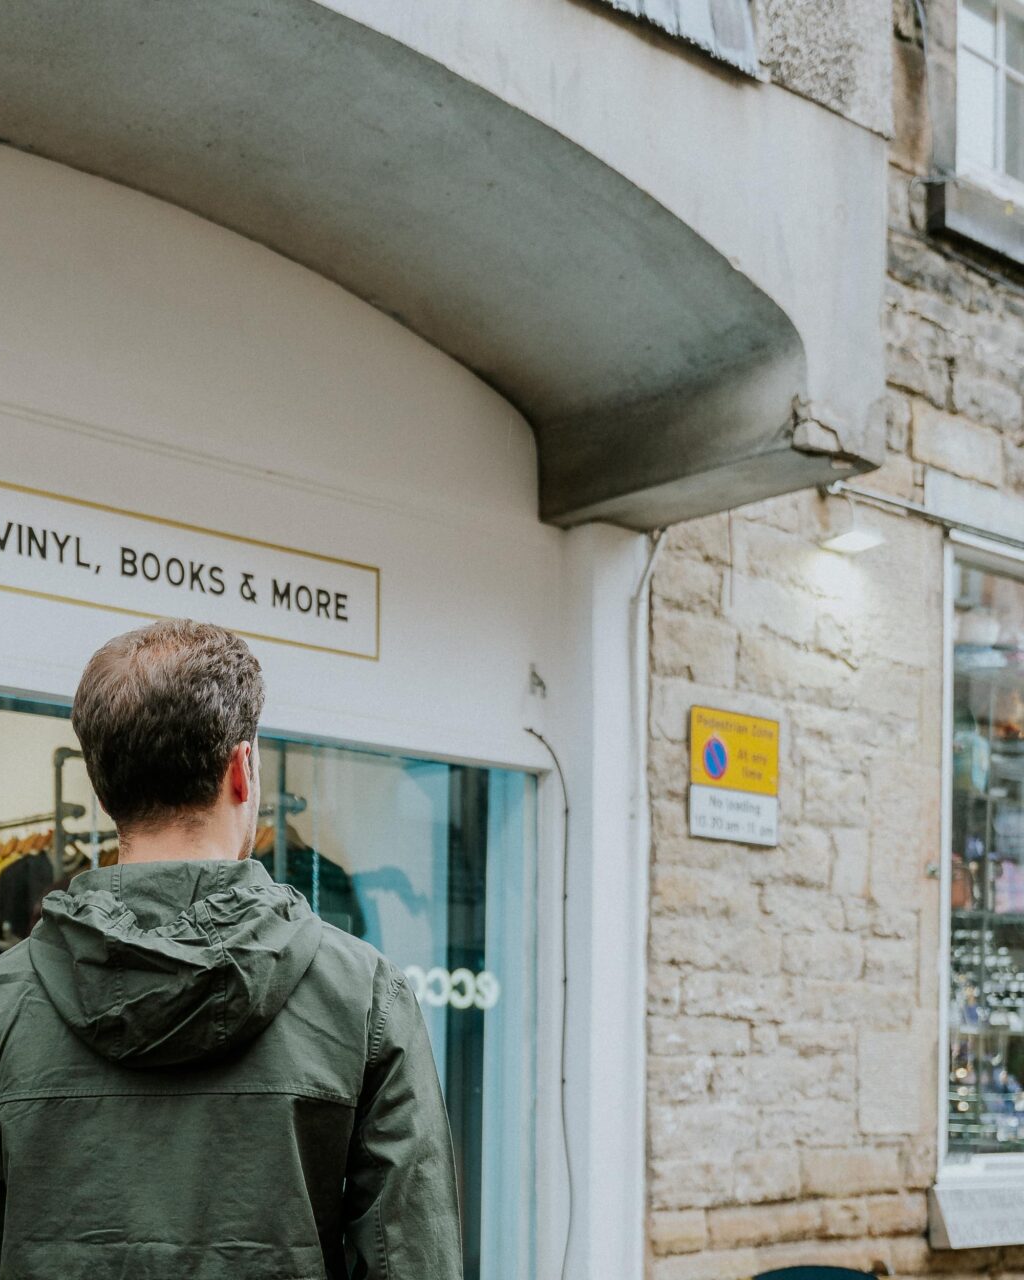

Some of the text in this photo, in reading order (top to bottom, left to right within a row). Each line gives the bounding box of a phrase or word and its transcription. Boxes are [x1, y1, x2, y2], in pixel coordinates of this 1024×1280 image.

[120, 546, 226, 596] BOOKS
[240, 573, 258, 602] &
[271, 578, 350, 622] MORE
